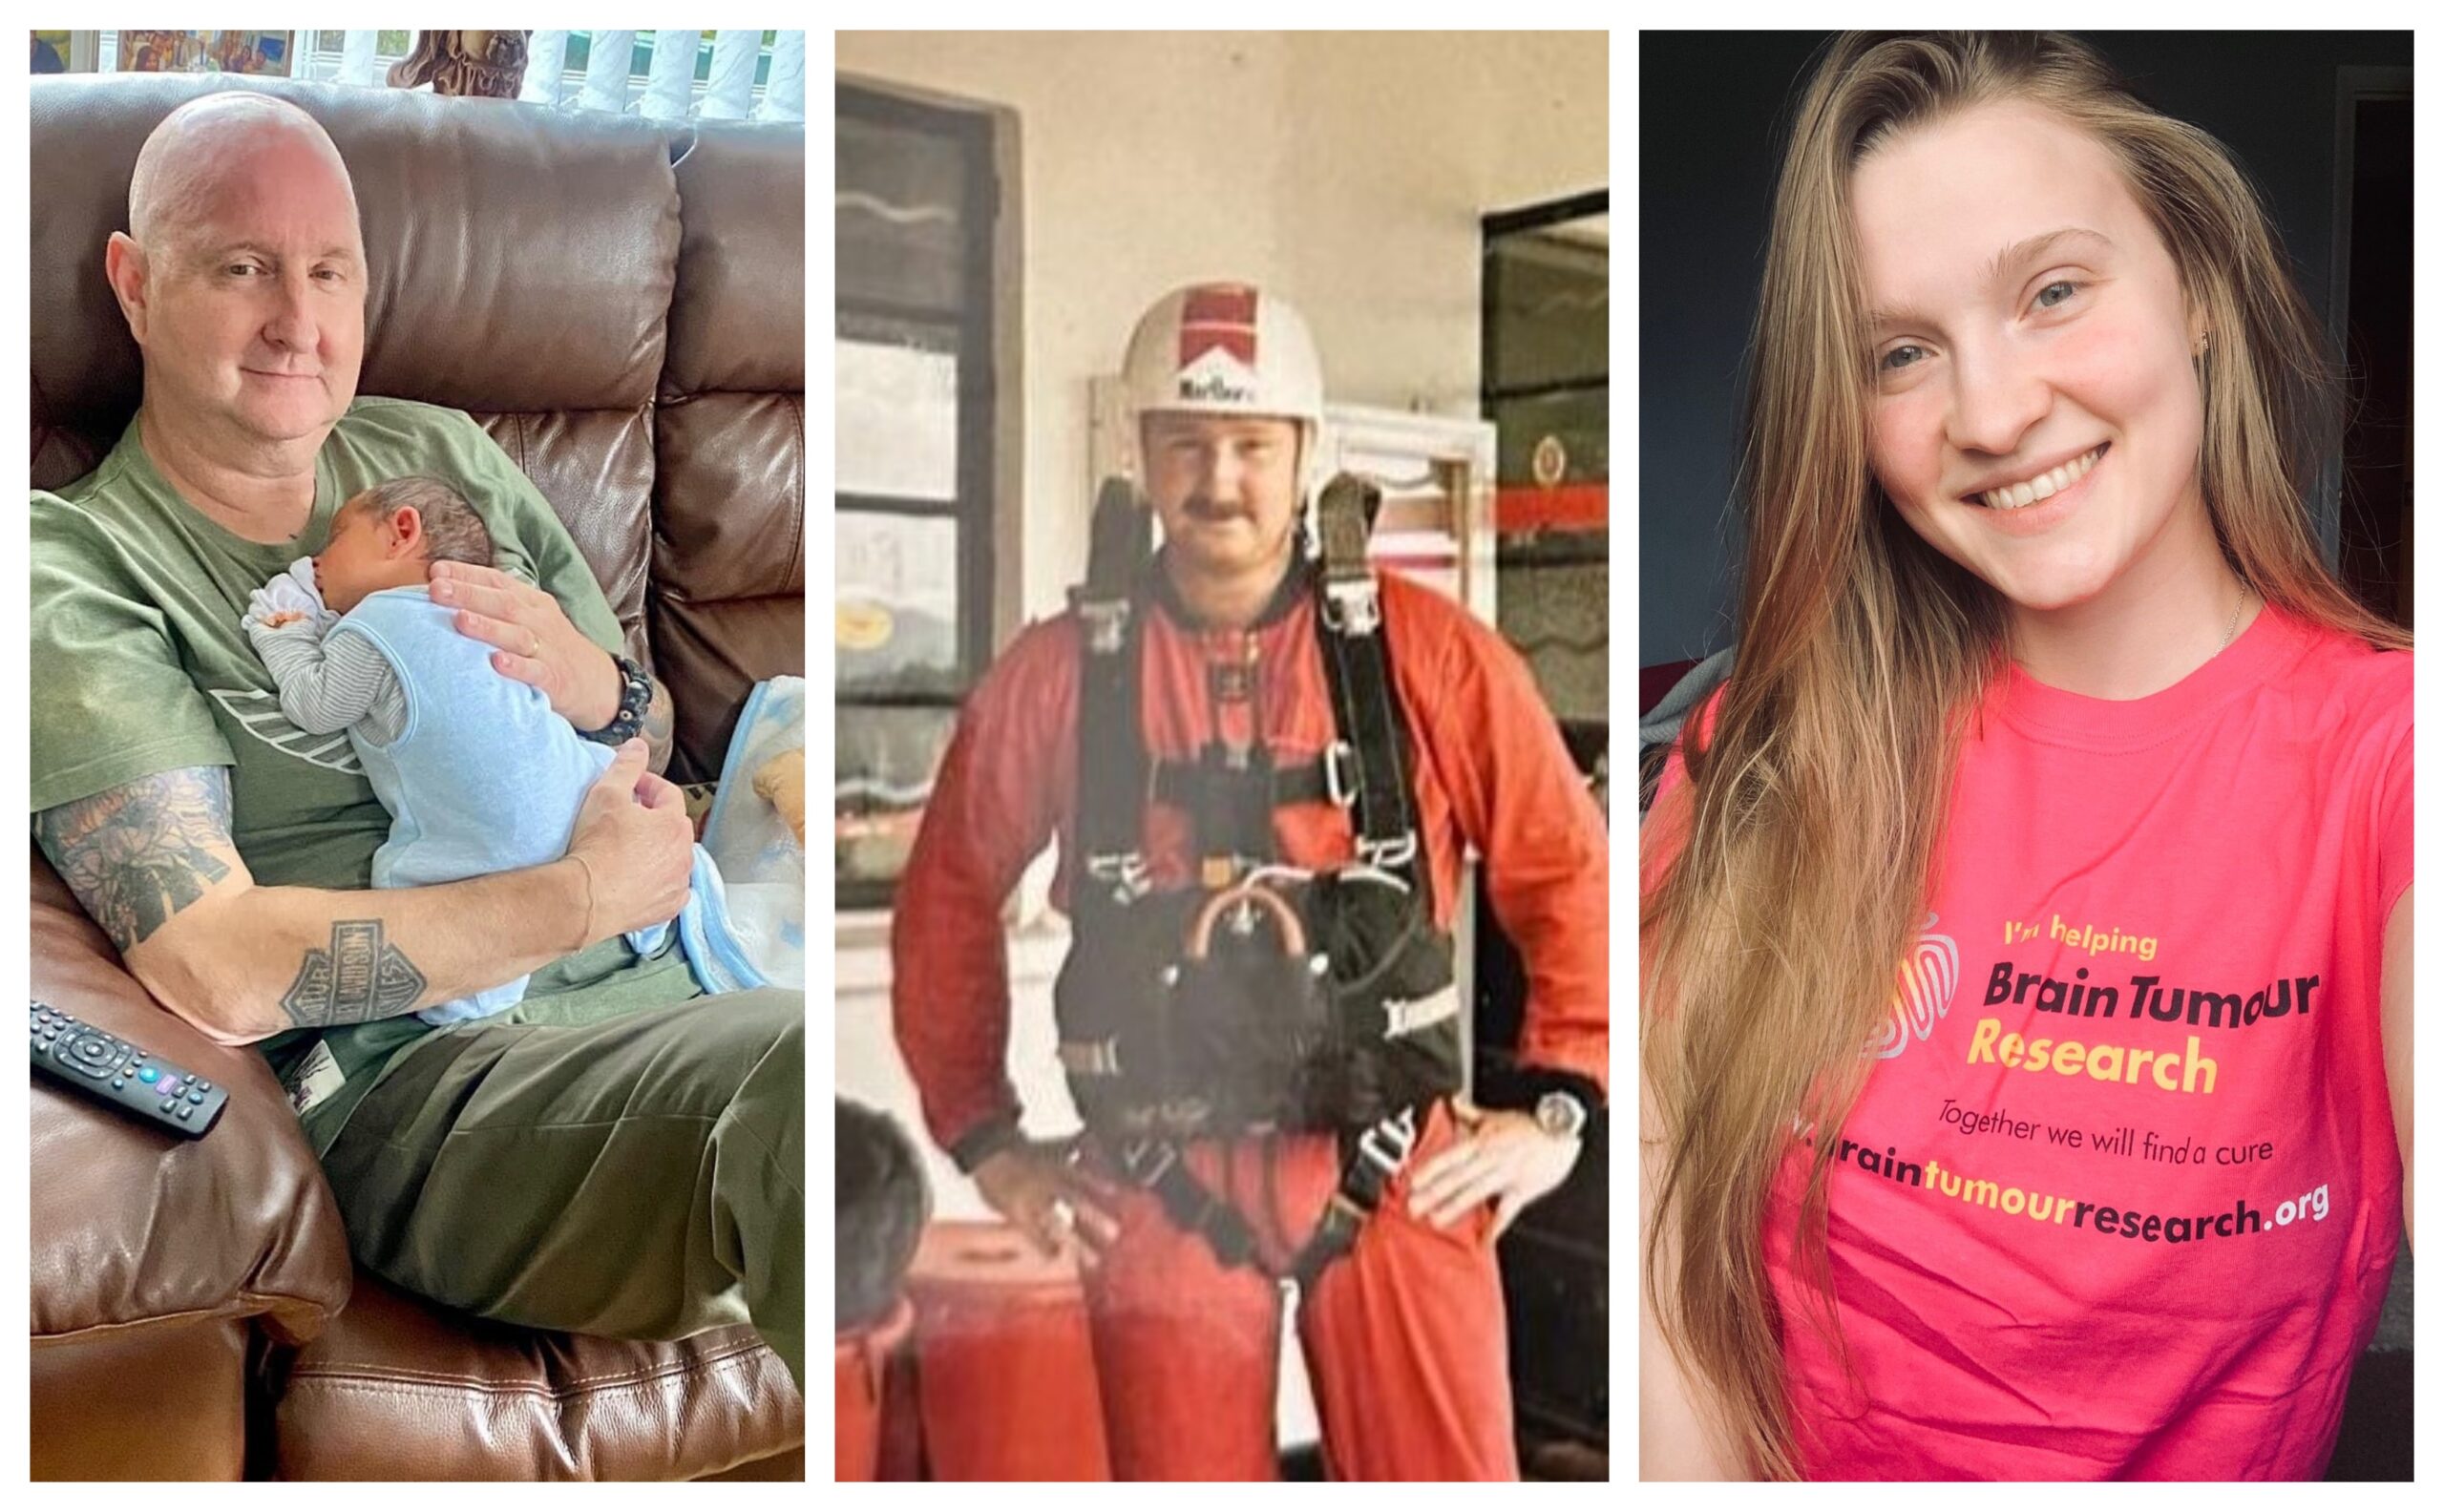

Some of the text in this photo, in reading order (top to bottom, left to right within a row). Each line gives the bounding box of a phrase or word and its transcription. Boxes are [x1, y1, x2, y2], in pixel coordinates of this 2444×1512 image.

[2005, 914, 2159, 962] I'm helping
[1983, 961, 2320, 1029] Brain Tumour
[1967, 1018, 2218, 1094] Research
[1939, 1099, 2274, 1166] Together we will find a cure
